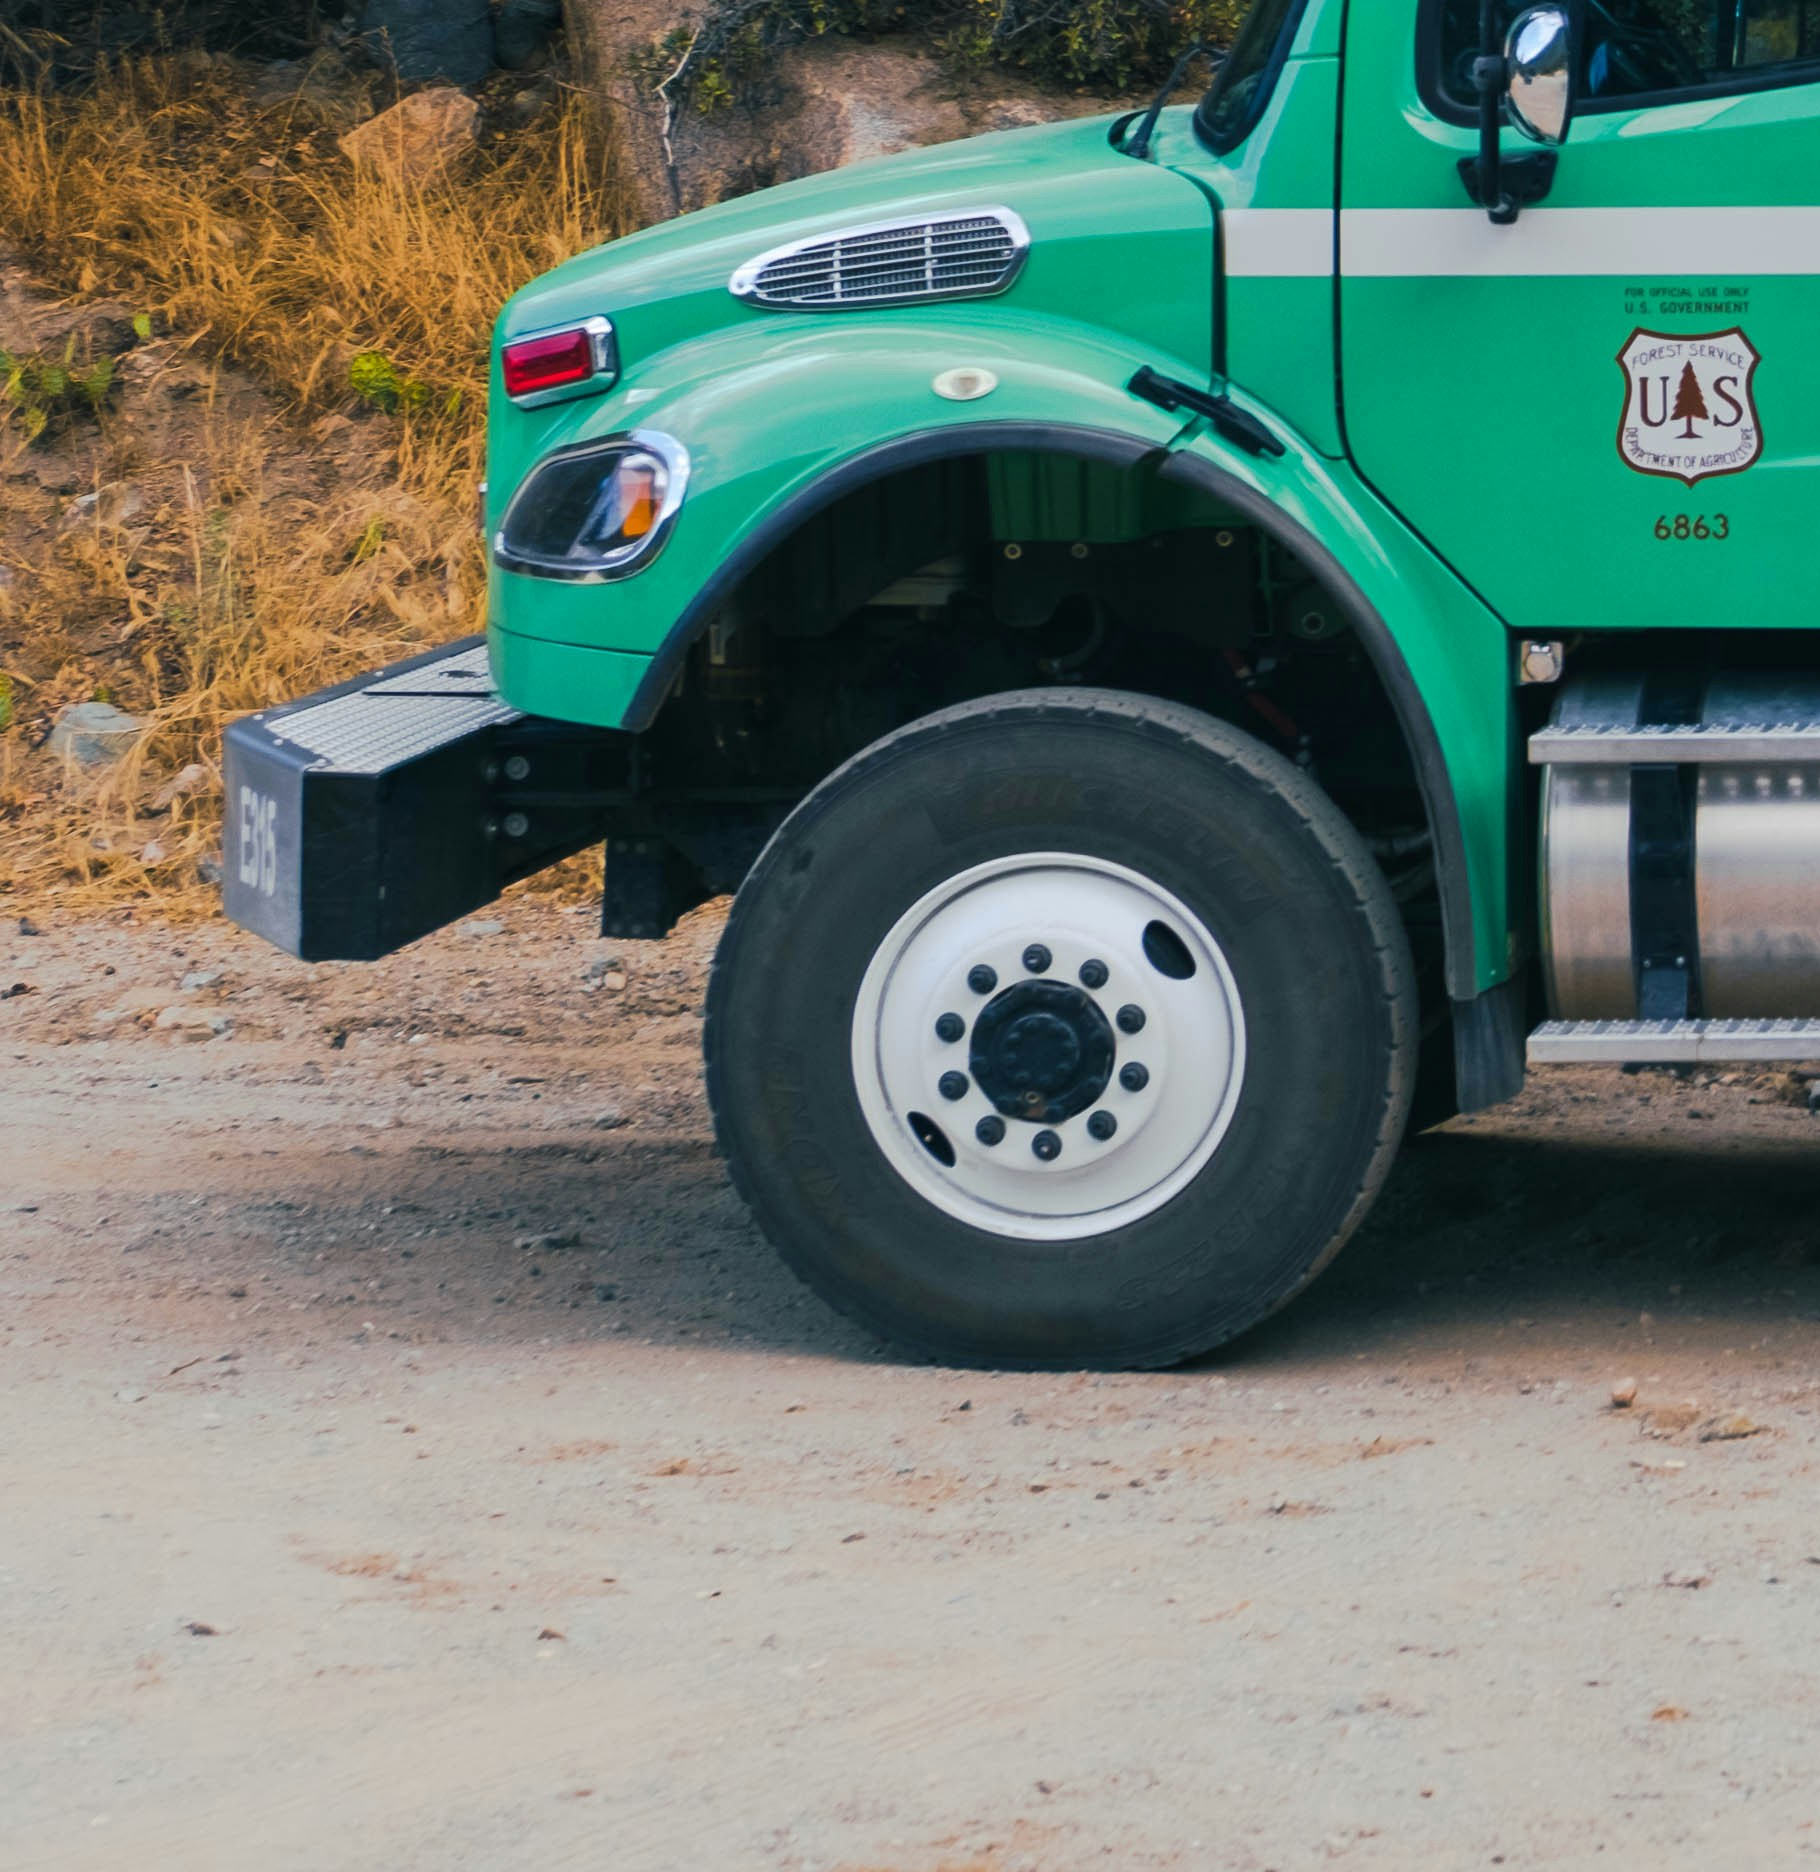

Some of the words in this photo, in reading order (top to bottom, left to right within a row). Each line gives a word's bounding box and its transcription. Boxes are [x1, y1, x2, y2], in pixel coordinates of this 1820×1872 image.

[1624, 287, 1645, 298] FOR
[1649, 287, 1693, 298] OFFICIAL
[1698, 287, 1718, 298] USE
[1723, 287, 1750, 298] ONLY
[1659, 301, 1750, 315] GOVERNMENT
[1632, 344, 1683, 369] FOREST
[1688, 343, 1745, 370] SERVICE
[1639, 376, 1669, 427] U
[1713, 376, 1743, 427] S
[1625, 427, 1682, 469] DEPARTMENT
[1683, 455, 1697, 469] OF
[1698, 427, 1754, 469] AGRICULTURE
[1654, 513, 1729, 541] 6863
